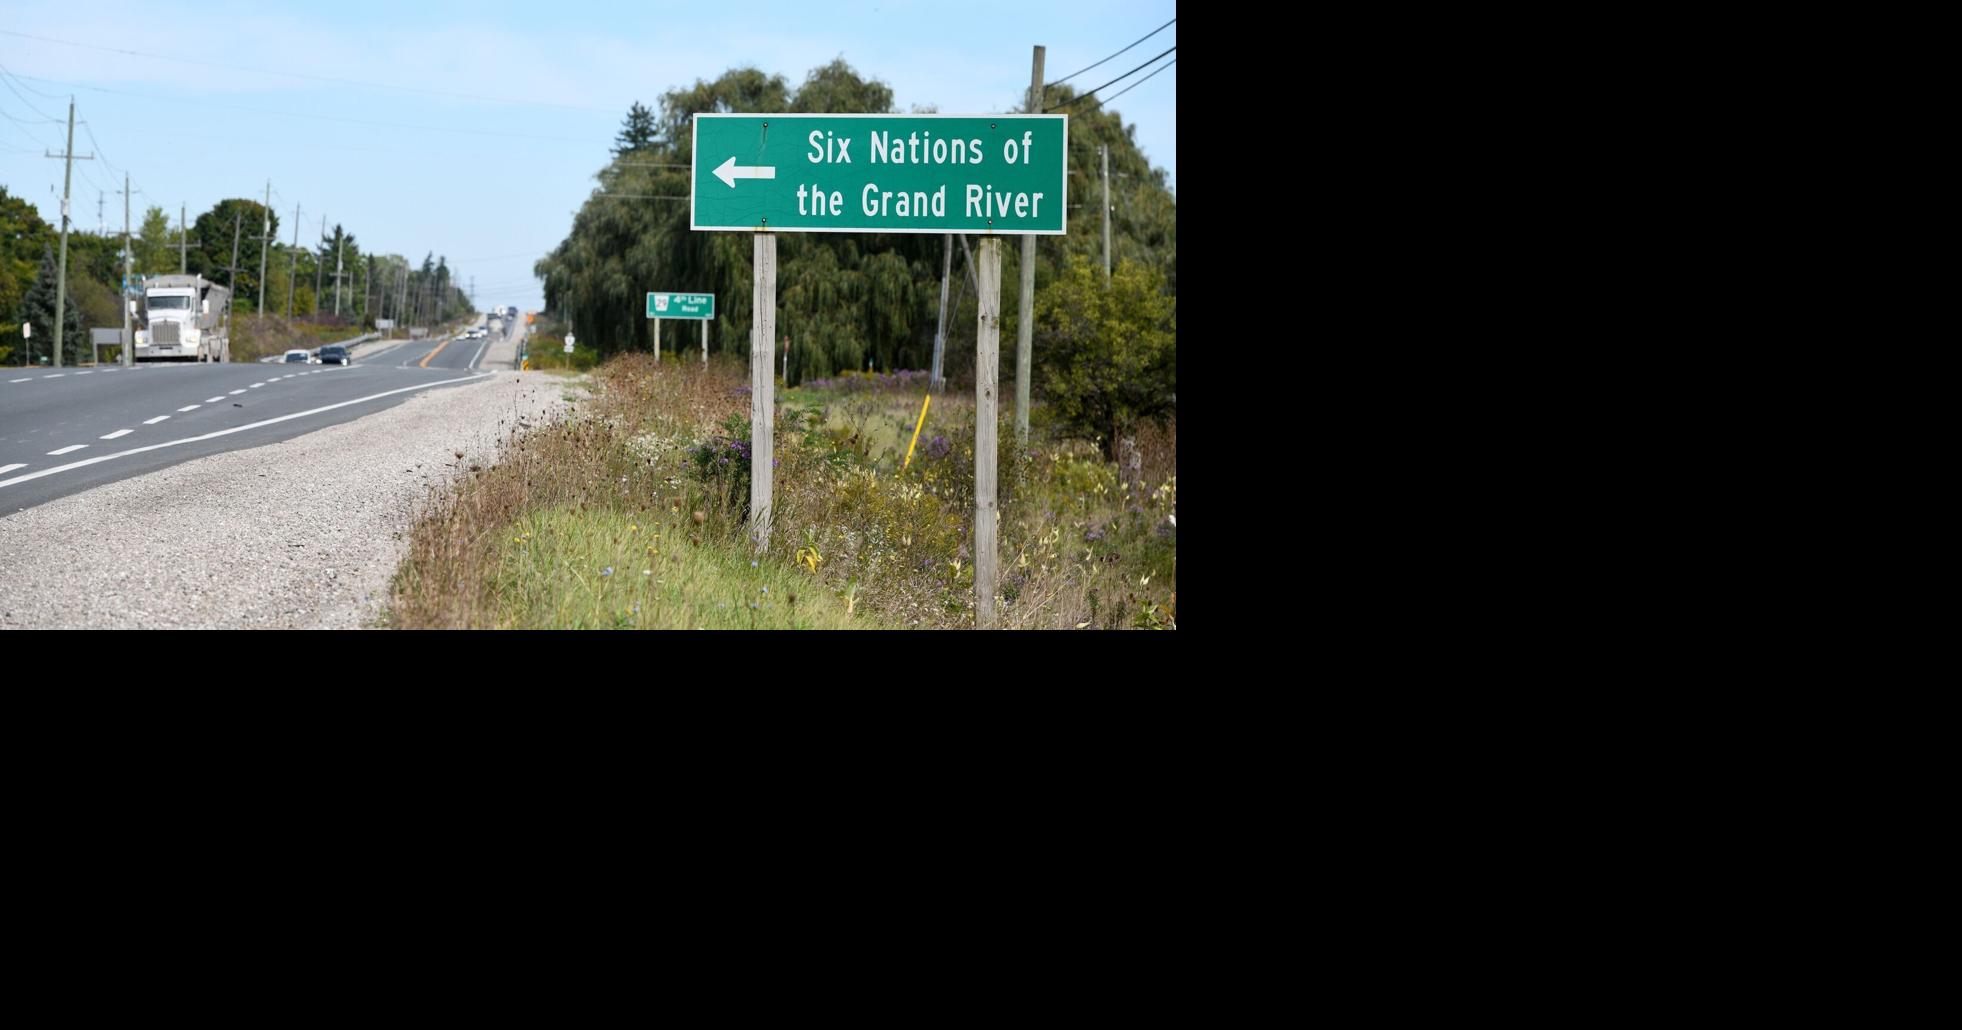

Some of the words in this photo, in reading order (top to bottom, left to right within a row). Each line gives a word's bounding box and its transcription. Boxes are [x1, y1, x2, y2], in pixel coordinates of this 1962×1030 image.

[808, 130, 852, 164] Six
[870, 130, 983, 165] Nations
[1003, 131, 1033, 165] of
[796, 183, 843, 216] the
[861, 183, 946, 217] Grand
[966, 184, 1044, 218] River
[688, 295, 707, 304] Line
